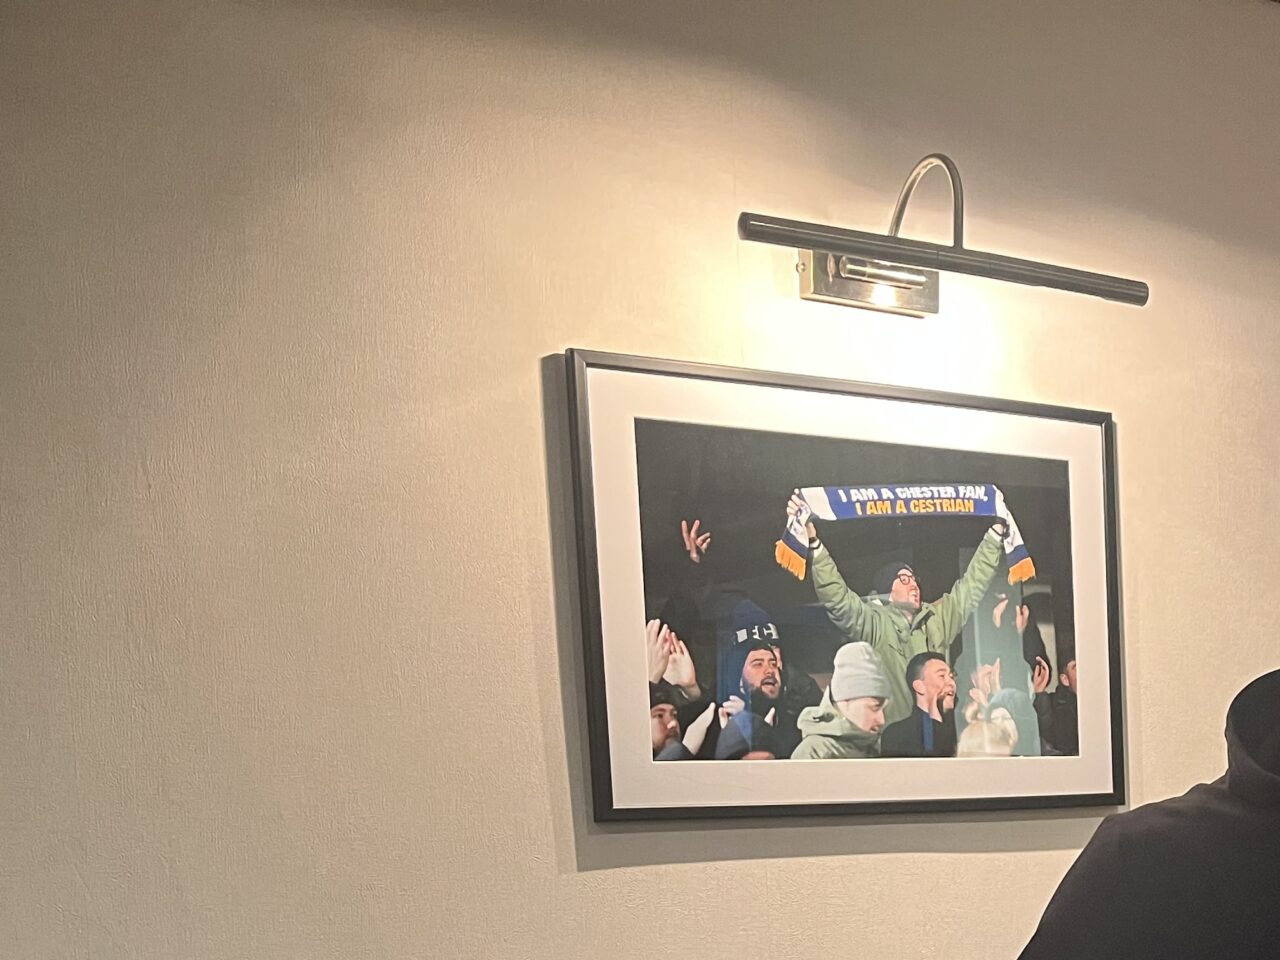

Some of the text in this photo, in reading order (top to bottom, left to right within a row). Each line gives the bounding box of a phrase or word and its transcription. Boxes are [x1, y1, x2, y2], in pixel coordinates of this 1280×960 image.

[838, 486, 988, 502] I AM A CHESTER FAN,
[855, 498, 974, 515] I AM A CESTRIAN
